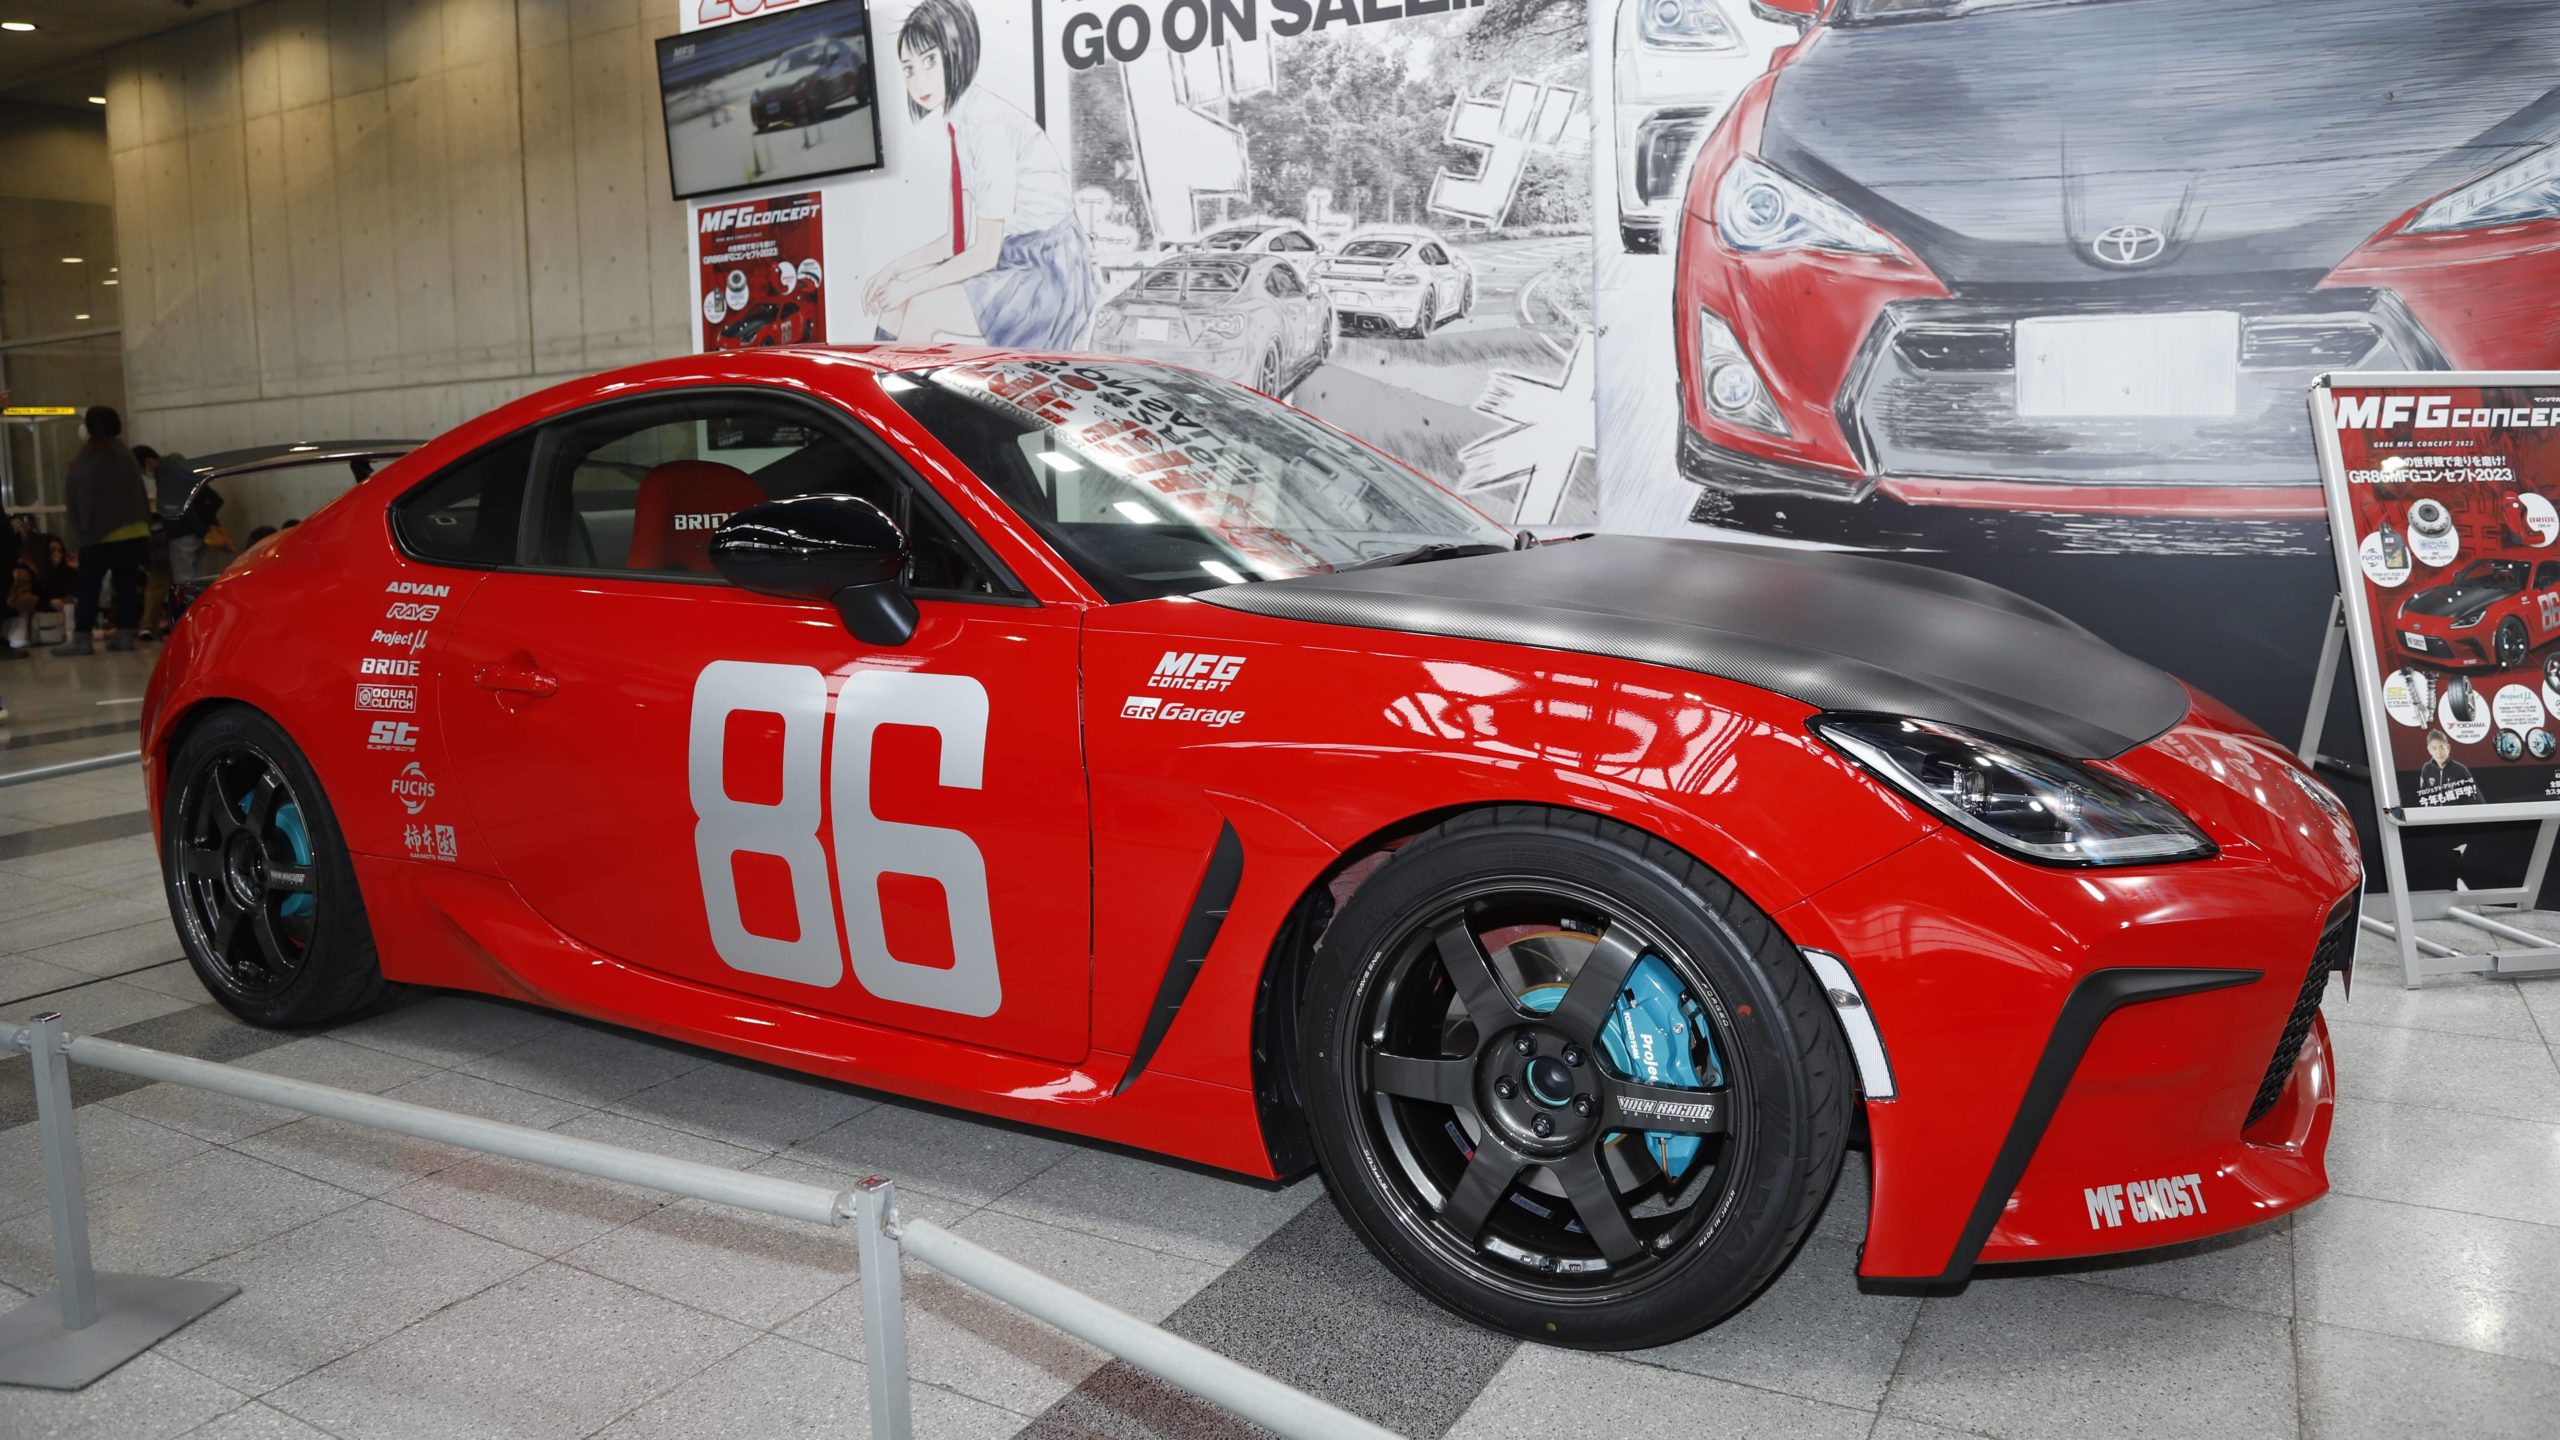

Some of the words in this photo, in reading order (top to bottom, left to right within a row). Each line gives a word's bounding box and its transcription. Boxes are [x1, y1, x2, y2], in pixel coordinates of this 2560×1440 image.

[1062, 4, 1151, 70] GO
[1162, 0, 1257, 53] ON
[700, 206, 755, 233] MFG
[2337, 395, 2451, 429] MFG
[2417, 440, 2453, 448] CONCEPT
[674, 512, 738, 531] BRID
[385, 581, 450, 597] ADVAN
[386, 602, 440, 622] RAYS
[371, 629, 414, 646] Project
[360, 658, 421, 676] BRIDE
[1153, 651, 1247, 681] MFG
[372, 688, 414, 699] OGURA
[1147, 675, 1232, 692] CONCEPT
[371, 698, 414, 710] CLUTCH
[1121, 701, 1160, 720] GR
[1158, 702, 1246, 728] Garage
[391, 779, 435, 797] FUCHS
[688, 659, 1002, 1018] 86
[1701, 982, 1730, 1027] FORGED
[1640, 1033, 1660, 1085] Projec
[1617, 1095, 1657, 1114] VOLK
[1654, 1100, 1715, 1119] RACING
[2083, 1183, 2125, 1231] MF
[2125, 1173, 2208, 1224] GHOST
[1698, 1226, 1715, 1248] MADE
[1714, 1217, 1721, 1229] IN
[1720, 1189, 1736, 1218] JAPAN
